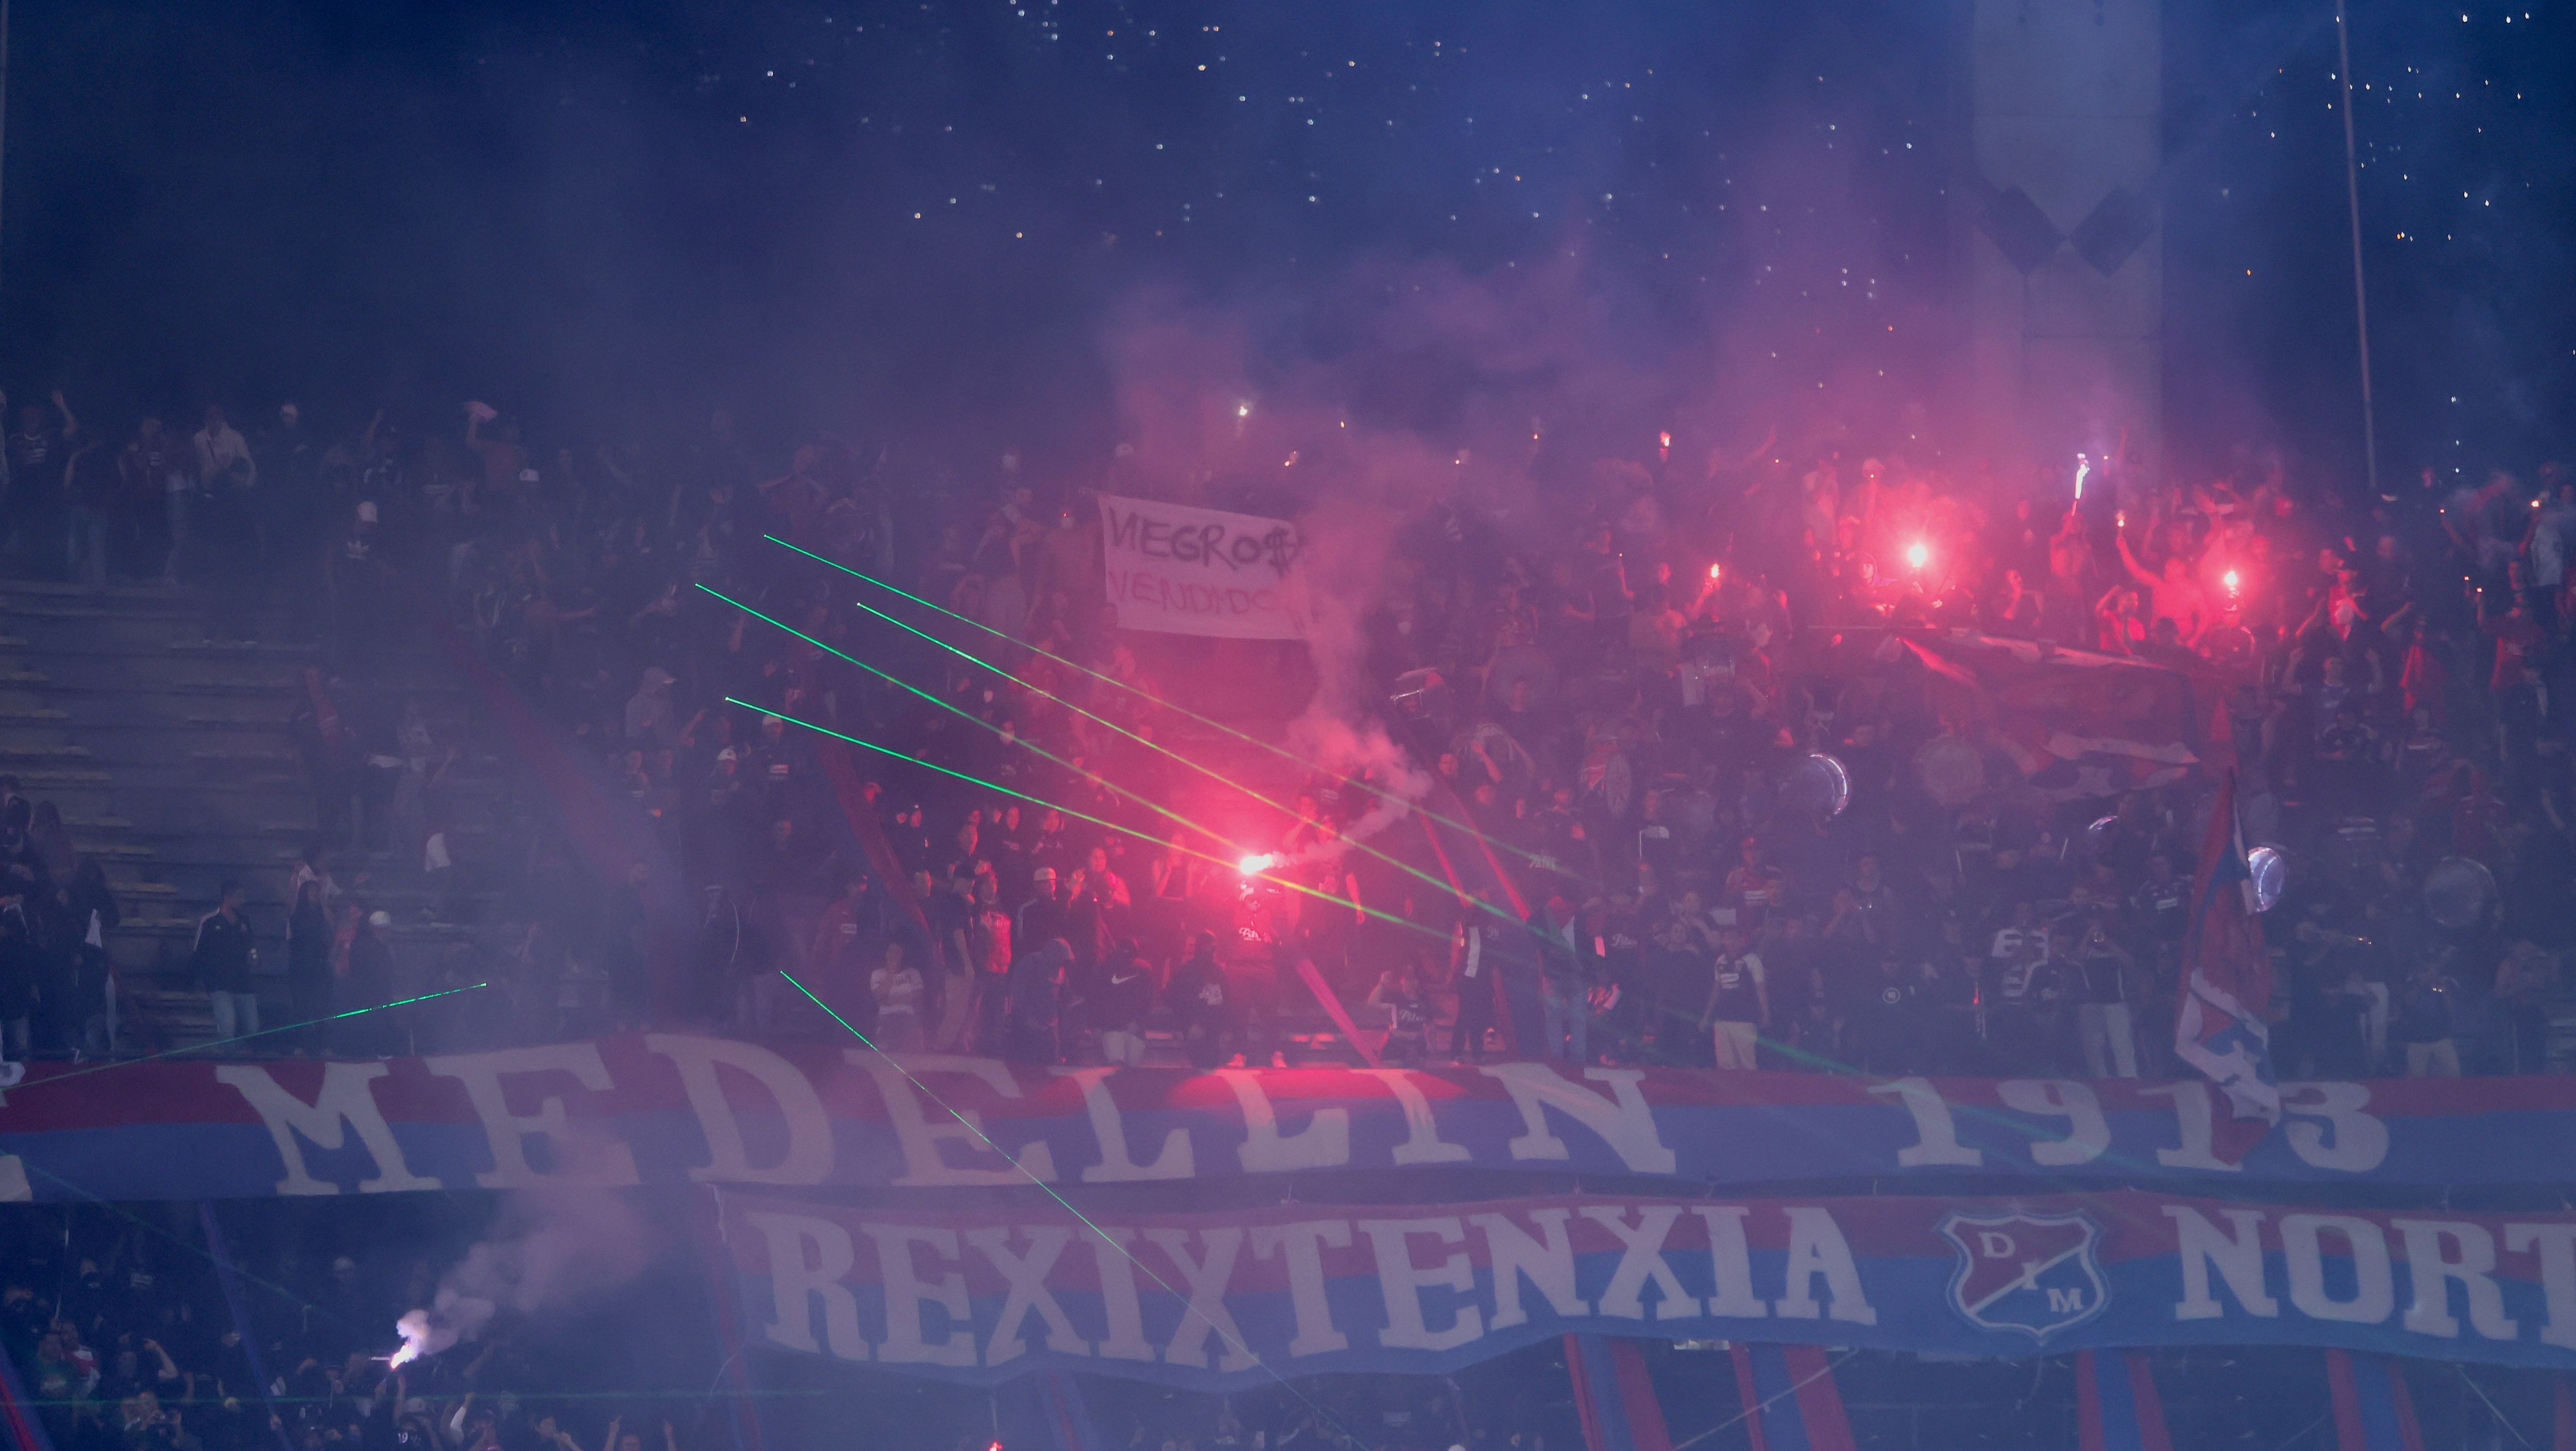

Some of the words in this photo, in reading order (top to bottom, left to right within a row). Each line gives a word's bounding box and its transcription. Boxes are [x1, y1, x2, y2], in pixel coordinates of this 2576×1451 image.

[216, 1033, 1676, 1196] MEDELLIN
[1867, 1077, 2389, 1172] 1913
[747, 1206, 1876, 1372] REXIXTENXIA
